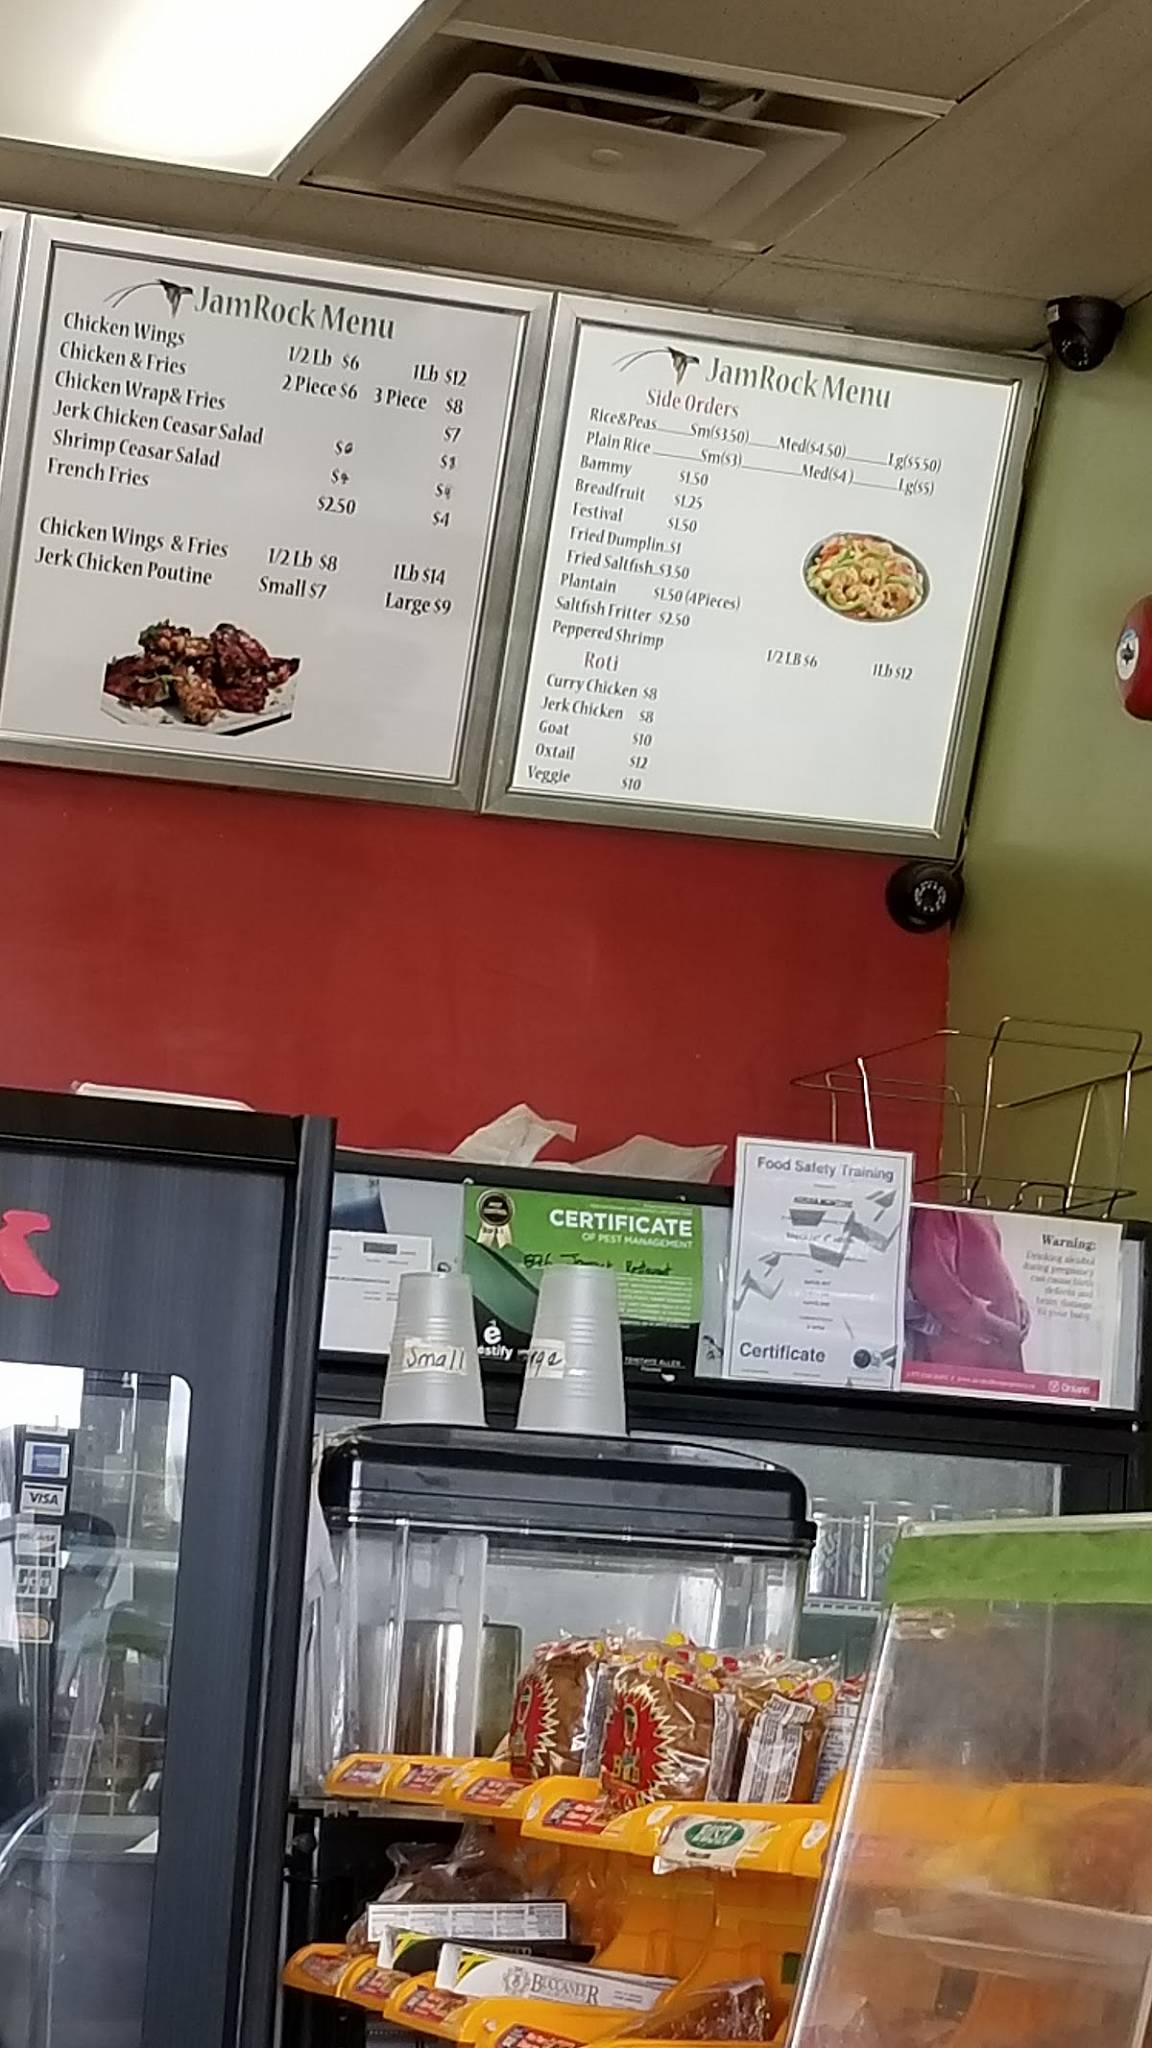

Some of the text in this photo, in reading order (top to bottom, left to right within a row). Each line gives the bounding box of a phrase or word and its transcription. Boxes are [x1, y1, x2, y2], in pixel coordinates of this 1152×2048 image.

[195, 286, 393, 339] JamRock Menu
[64, 312, 184, 348] Chicken Wings
[60, 341, 185, 374] Chicken & Fries
[289, 346, 359, 370] 1/2 Lb $6
[283, 374, 357, 399] 2 Piece $6
[445, 369, 467, 386] $12
[706, 358, 890, 408] JamRock Menu
[55, 370, 120, 395] Chicken
[186, 389, 225, 410] Fries
[375, 388, 463, 414] 3 Piece $8
[648, 389, 738, 417] Side Orders
[53, 400, 263, 444] Jerk Chicken Ceasar Salad
[444, 427, 461, 442] $7
[587, 431, 620, 449] Plain
[624, 437, 650, 453] Rice
[53, 429, 220, 467] Shrimp Ceasar Salad
[48, 457, 148, 486] French Fries
[581, 455, 632, 477] Bammy
[576, 478, 644, 501] Breadfruit
[433, 511, 449, 527] $4
[573, 502, 623, 522] Festival
[40, 517, 228, 557] Chicken Wings & Fries
[570, 526, 605, 543] Fried
[35, 547, 212, 585] Jerk Chicken Poutine
[269, 548, 337, 571] 1/2 Lb $8
[568, 550, 601, 567] Fried
[259, 576, 327, 598] Small $7
[422, 568, 445, 585] $14
[561, 573, 616, 593] Plantain
[386, 592, 451, 615] Large $9
[557, 596, 605, 615] Saltfish
[608, 604, 651, 622] Fritter
[553, 620, 663, 650] Peppered Shrimp
[585, 651, 618, 671] Roti
[805, 655, 817, 667] $6
[896, 667, 912, 680] $12
[547, 674, 657, 700] Curry Chicken $8
[542, 696, 654, 723] Jerk Chicken $8
[539, 720, 652, 746] Goat $10
[536, 743, 647, 769] Oxtail $12
[528, 765, 641, 790] Veggie $10
[758, 1157, 894, 1183] Food Safety Training
[550, 1209, 692, 1237] CERTIFICATE
[581, 1232, 596, 1242] OF
[598, 1234, 622, 1244] PEST
[406, 1346, 465, 1370] Small
[740, 1342, 825, 1362] Certificate
[29, 1492, 59, 1506] VISA
